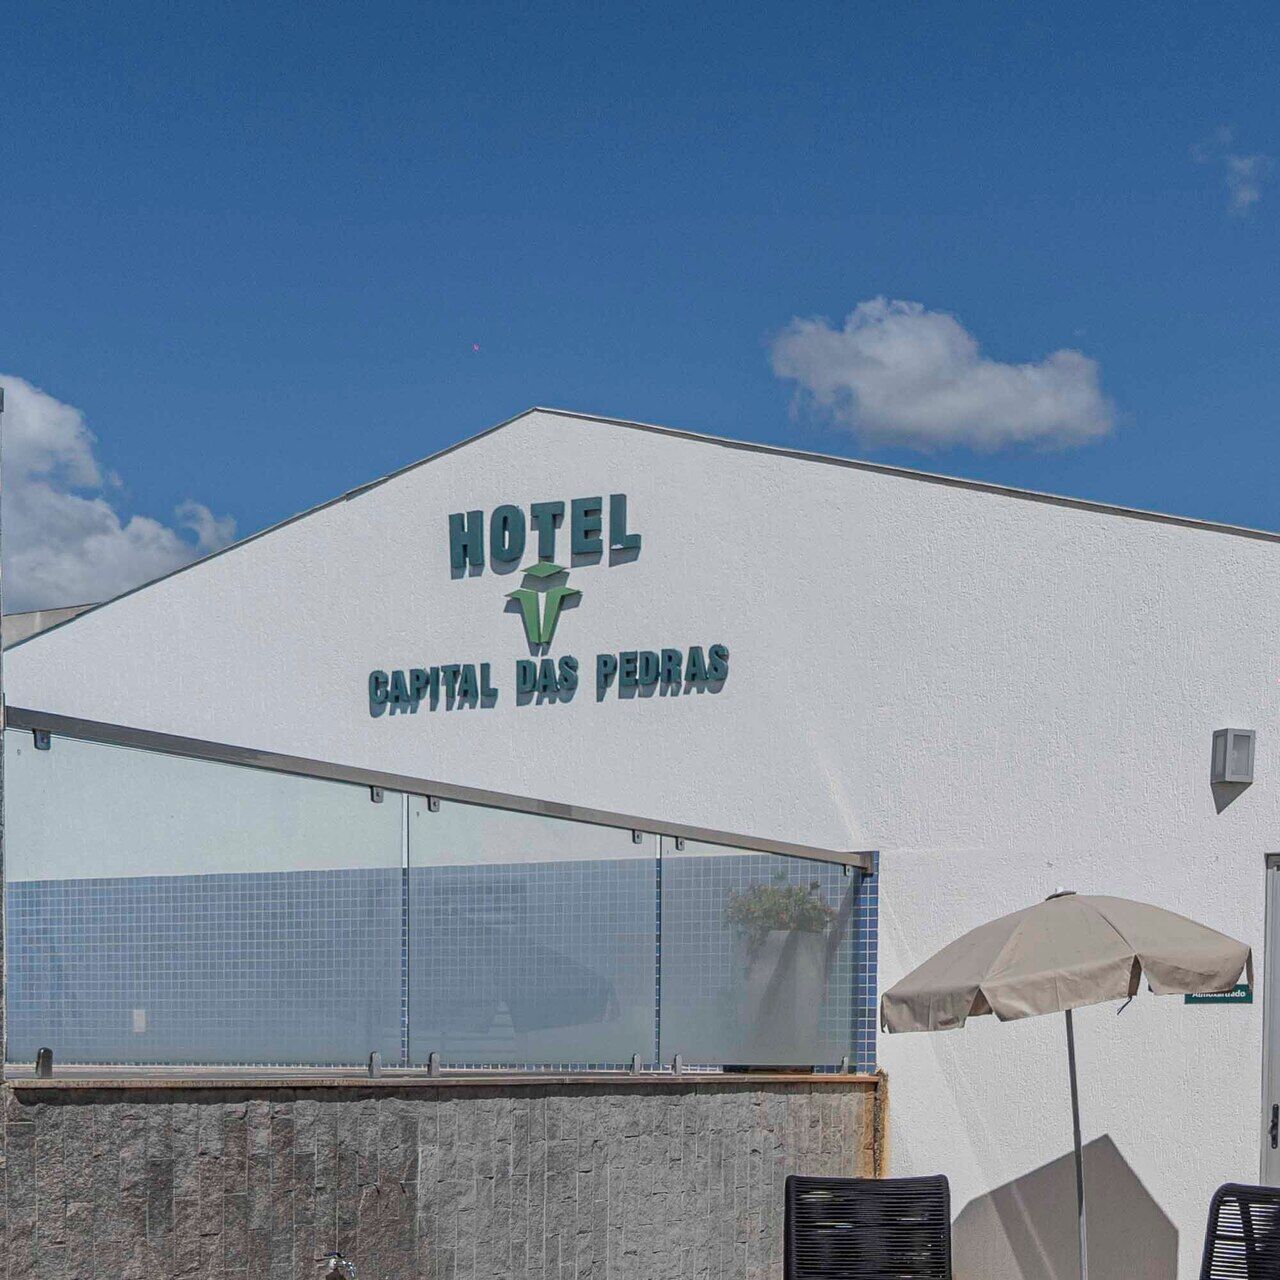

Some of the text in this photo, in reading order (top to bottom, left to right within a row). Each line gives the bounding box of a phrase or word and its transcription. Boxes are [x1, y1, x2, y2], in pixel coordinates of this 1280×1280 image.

[448, 493, 642, 571] HOTEL
[368, 643, 729, 706] CAPITAL DAS PEDRAS
